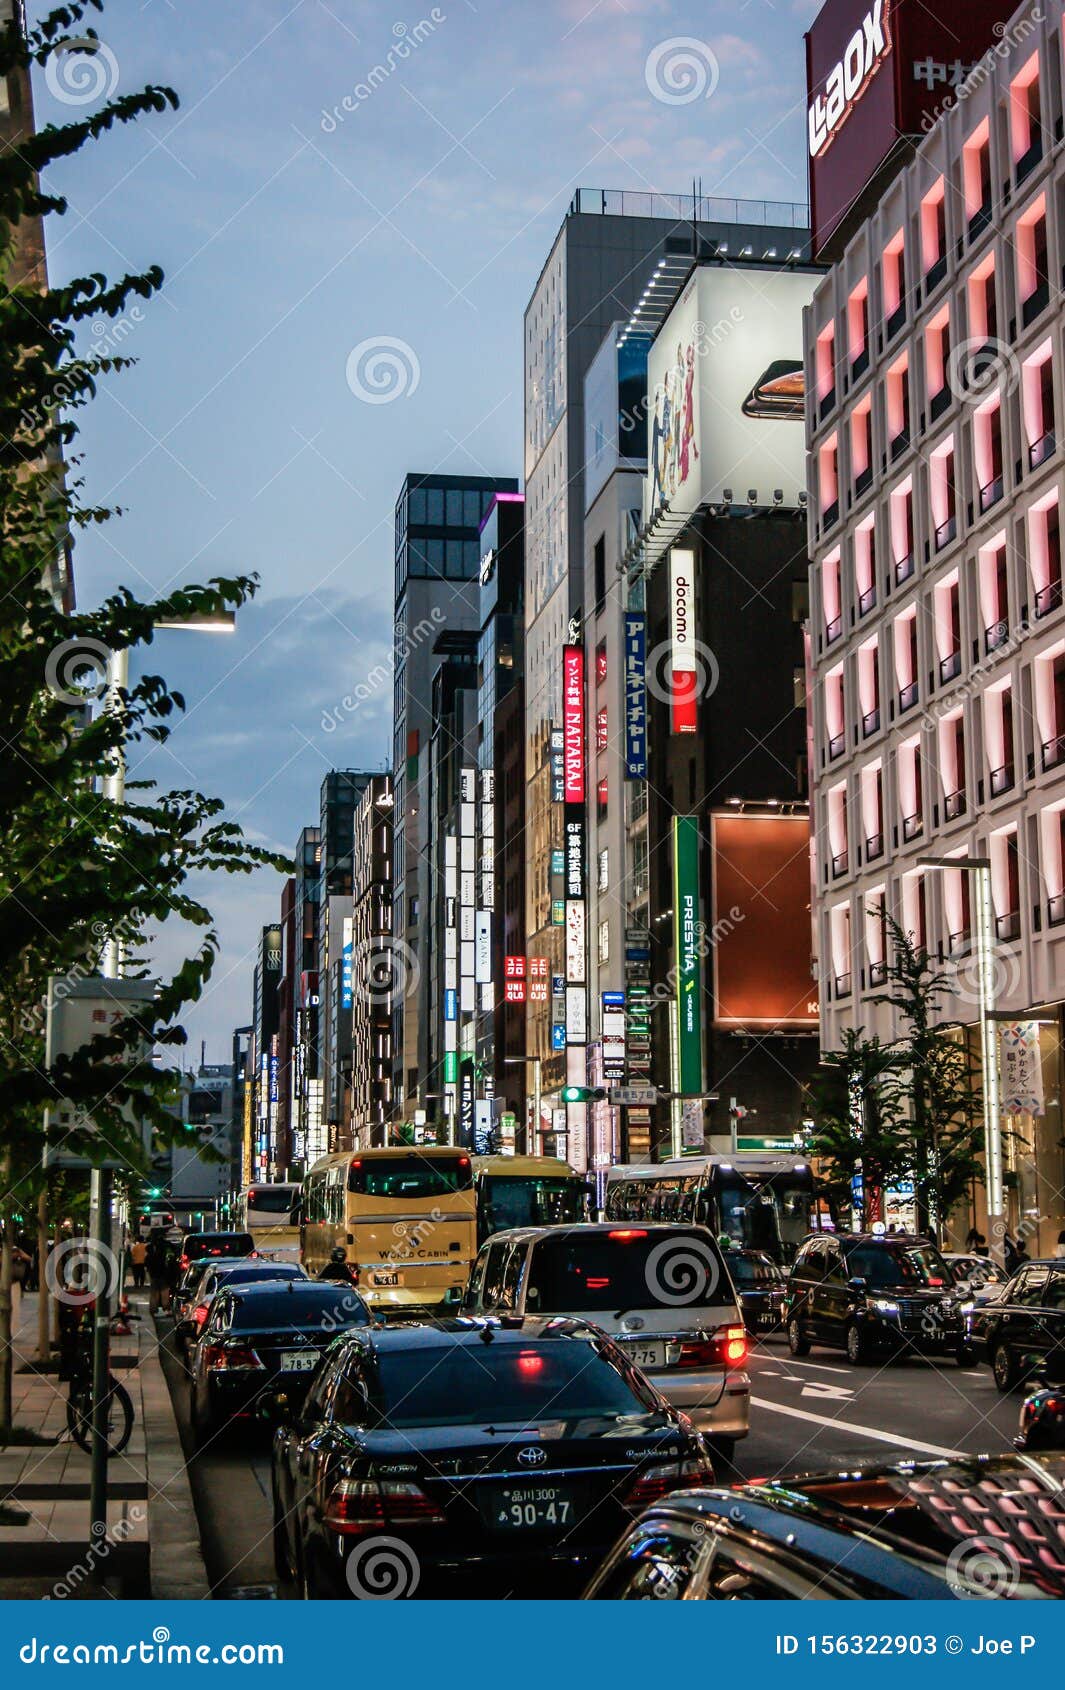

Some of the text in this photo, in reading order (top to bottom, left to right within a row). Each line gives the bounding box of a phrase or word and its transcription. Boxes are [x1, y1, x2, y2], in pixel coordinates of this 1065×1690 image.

[676, 576, 690, 643] docomo
[567, 658, 580, 705] インド料理
[626, 621, 644, 754] アートネイチャー
[567, 712, 581, 791] NATARAJ
[629, 763, 645, 773] 6F
[567, 823, 581, 833] 6F
[507, 958, 523, 966] ユニ
[507, 967, 523, 975] クロ
[507, 983, 522, 991] UNI
[507, 992, 523, 1000] QLO
[417, 1249, 449, 1258] CABIN
[511, 1501, 569, 1526] 90-47
